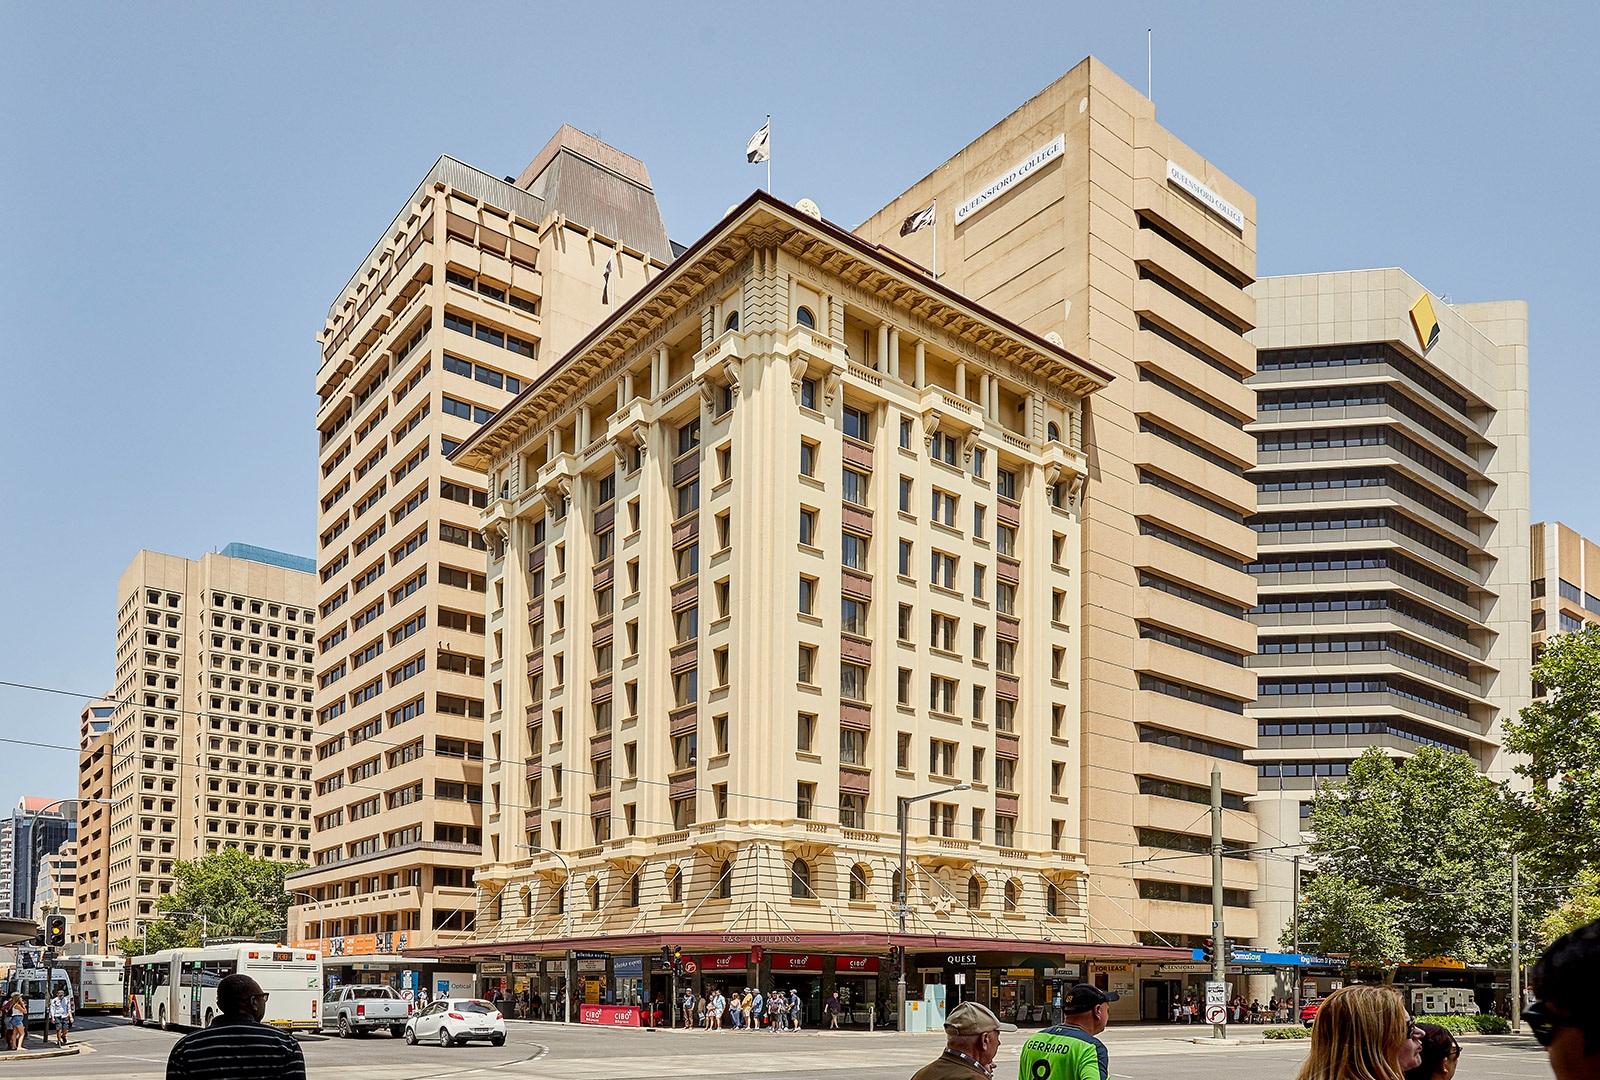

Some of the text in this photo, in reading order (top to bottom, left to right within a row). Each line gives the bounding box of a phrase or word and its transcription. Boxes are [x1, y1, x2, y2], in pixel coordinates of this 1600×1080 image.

[958, 142, 1060, 217] QUEENSFORD COLLEGE
[1171, 168, 1242, 224] QUEENSFORD COLLEGE
[751, 935, 801, 943] BUILDING
[717, 957, 730, 965] CIBO
[947, 955, 977, 964] QUEST
[586, 1010, 600, 1019] CIBO
[614, 1012, 630, 1020] CIBO
[1027, 1040, 1070, 1055] GERRARD
